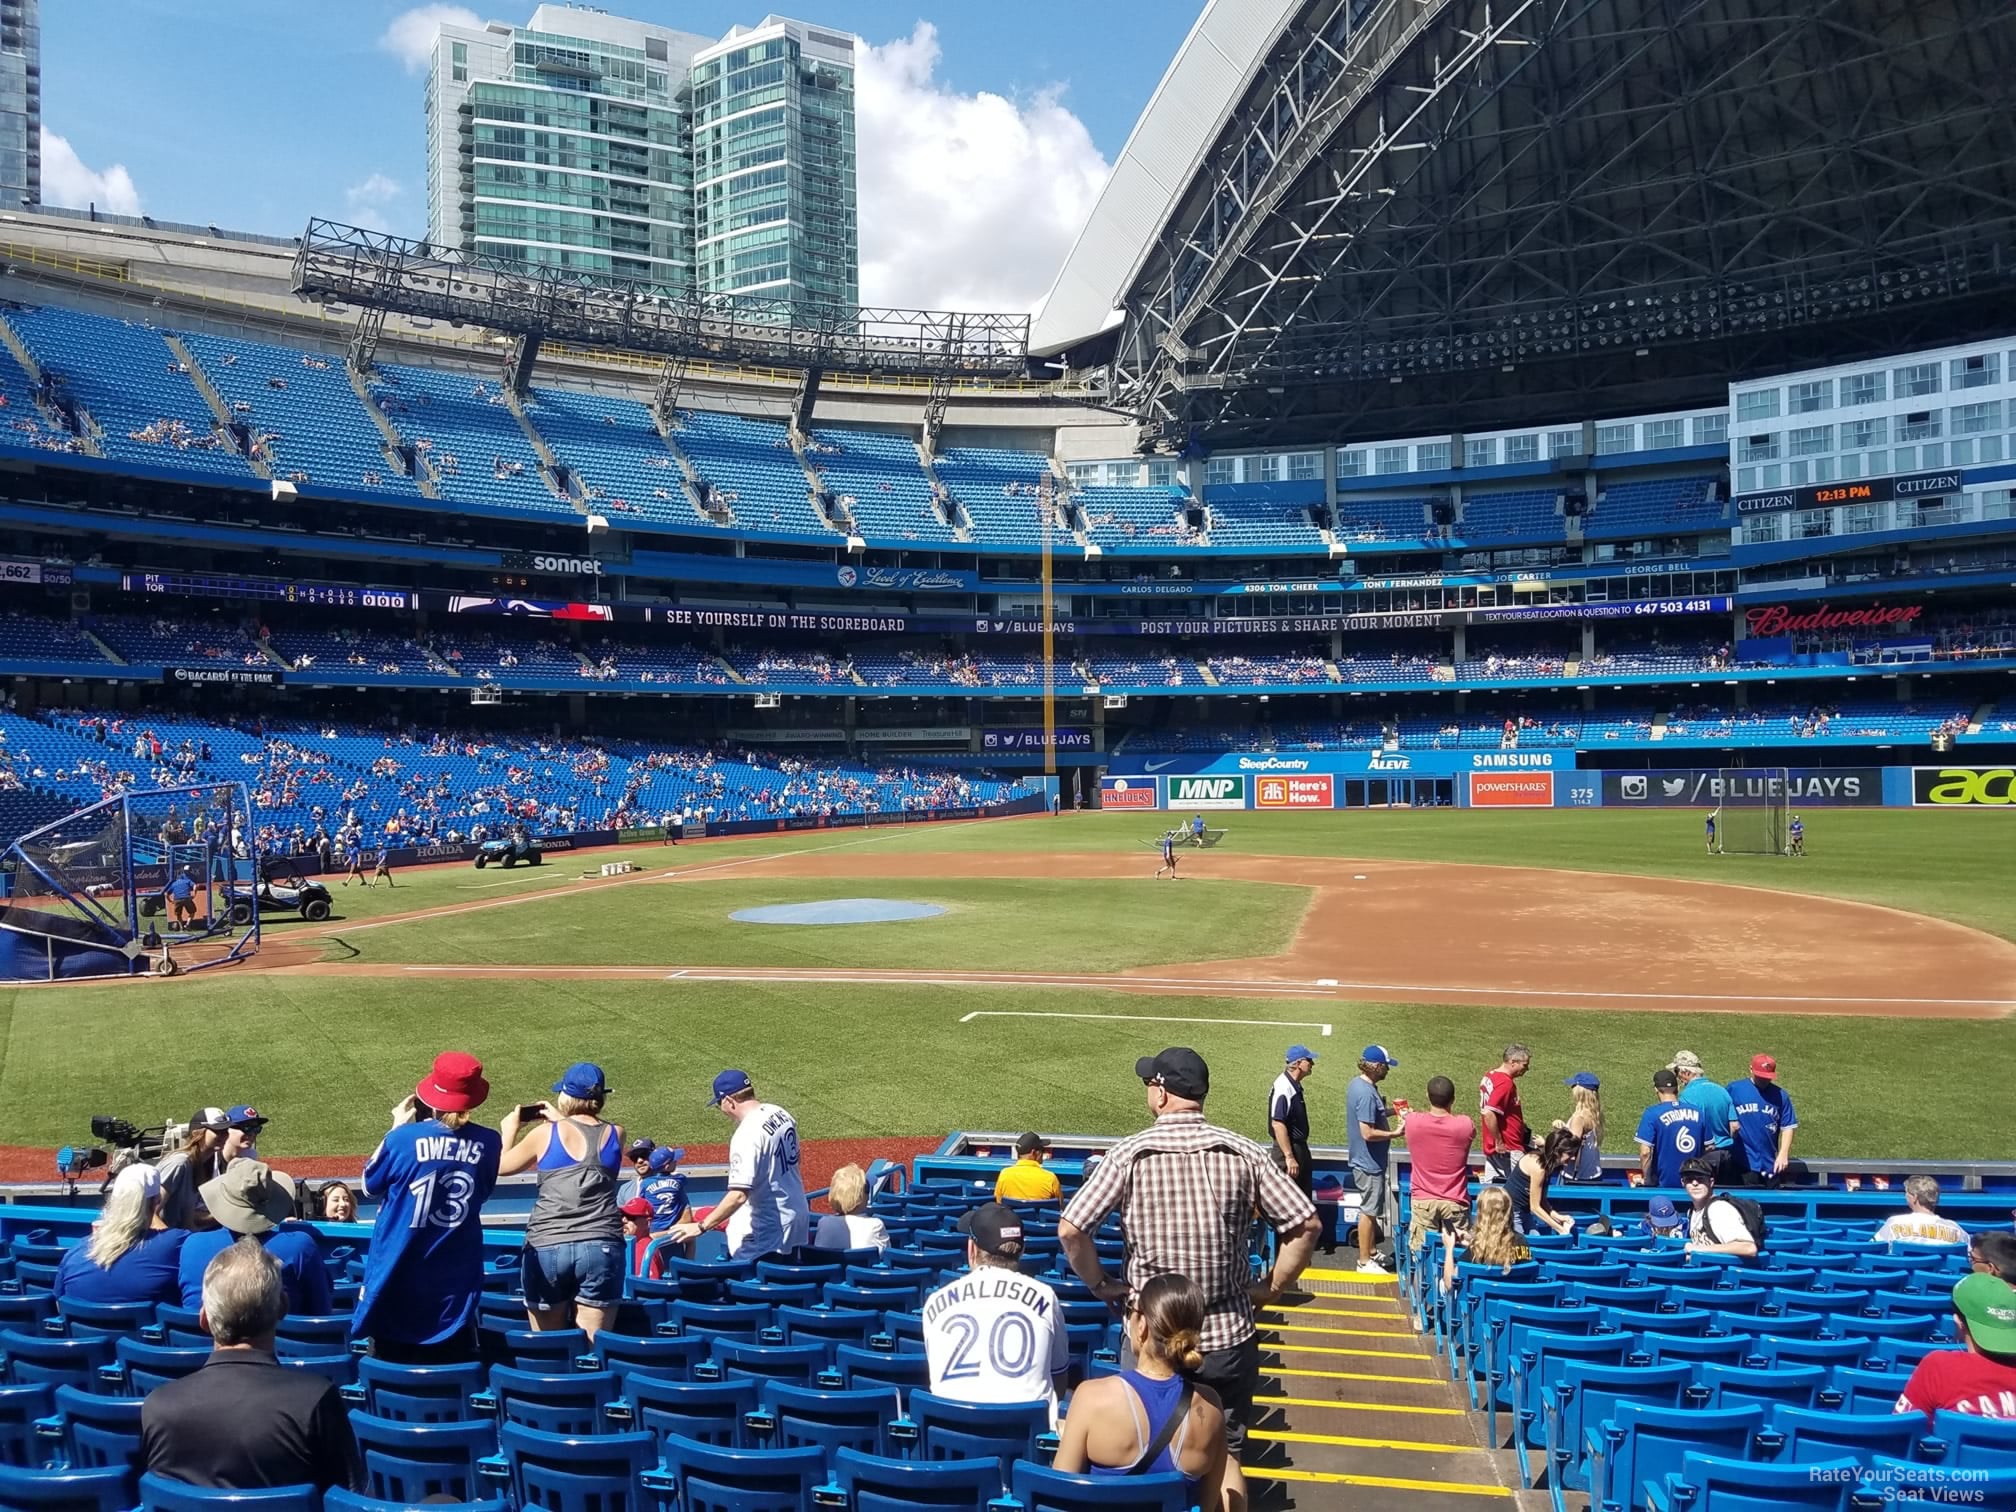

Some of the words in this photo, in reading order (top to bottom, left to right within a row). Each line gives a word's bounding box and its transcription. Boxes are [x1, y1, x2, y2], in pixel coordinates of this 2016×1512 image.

[1896, 475, 1958, 493] CITIZEN
[1816, 488, 1847, 502] 12:13
[1850, 486, 1871, 498] PM
[1738, 495, 1794, 512] CITIZEN
[0, 565, 31, 579] ,662
[534, 556, 602, 574] sonnet
[1625, 565, 1664, 574] GEORGE
[1668, 563, 1690, 571] BELL
[44, 574, 71, 584] 50/50
[145, 574, 159, 582] PIT
[862, 567, 900, 586] Level
[898, 573, 912, 587] of
[912, 571, 964, 588] Excellence
[1391, 578, 1442, 588] FERNANDEZ
[1495, 574, 1512, 582] JOE
[1517, 572, 1552, 580] CARTER
[145, 584, 164, 592] TOR
[1244, 584, 1265, 592] 4306
[1268, 584, 1287, 592] TOM
[1291, 583, 1318, 591] CHEEK
[366, 596, 371, 604] 0
[395, 598, 400, 606] 0
[1485, 612, 1500, 621] TEXT
[1501, 612, 1522, 620] YOUR
[1523, 610, 1540, 619] SEAT
[1540, 608, 1576, 618] LOCATION
[1577, 608, 1583, 617] &
[1584, 607, 1620, 617] QUESTION
[1621, 606, 1631, 615] TO
[1634, 603, 1658, 615] 647
[1660, 602, 1683, 613] 503
[1685, 600, 1711, 611] 4131
[666, 610, 692, 624] SEE
[696, 611, 764, 627] YOURSELF
[769, 614, 786, 628] ON
[791, 616, 816, 629] THE
[821, 616, 905, 631] SCOREBOARD
[1141, 622, 1172, 634] POST
[1176, 622, 1209, 633] YOUR
[1214, 620, 1276, 633] PICTURES
[1281, 620, 1290, 631] &
[1294, 619, 1337, 631] SHARE
[1342, 616, 1378, 630] YOUR
[1383, 614, 1442, 628] MOMENT
[1745, 602, 1922, 636] Budweiser
[188, 670, 230, 681] BACARDÍ
[240, 673, 252, 682] THE
[254, 674, 272, 682] PARK
[1239, 757, 1309, 770] SleepCountry
[1473, 753, 1552, 767] SAMSUNG
[1178, 780, 1234, 798] MNP
[1289, 780, 1327, 791] Here's
[1570, 788, 1594, 798] 375
[1929, 769, 2016, 804] ac
[1103, 792, 1150, 804] HNEIDERS
[1289, 792, 1320, 802] How.
[330, 852, 380, 864] HODA
[417, 845, 464, 857] HONDA
[1736, 1103, 1758, 1115] BLUE
[1660, 1108, 1699, 1126] STROMAN
[1676, 1126, 1696, 1153] 6
[416, 1137, 484, 1164] OWENS
[774, 1127, 800, 1176] 13
[409, 1170, 475, 1228] 13
[656, 1192, 674, 1214] 2
[927, 1280, 1050, 1324] DONALDSON
[941, 1311, 1036, 1382] 20
